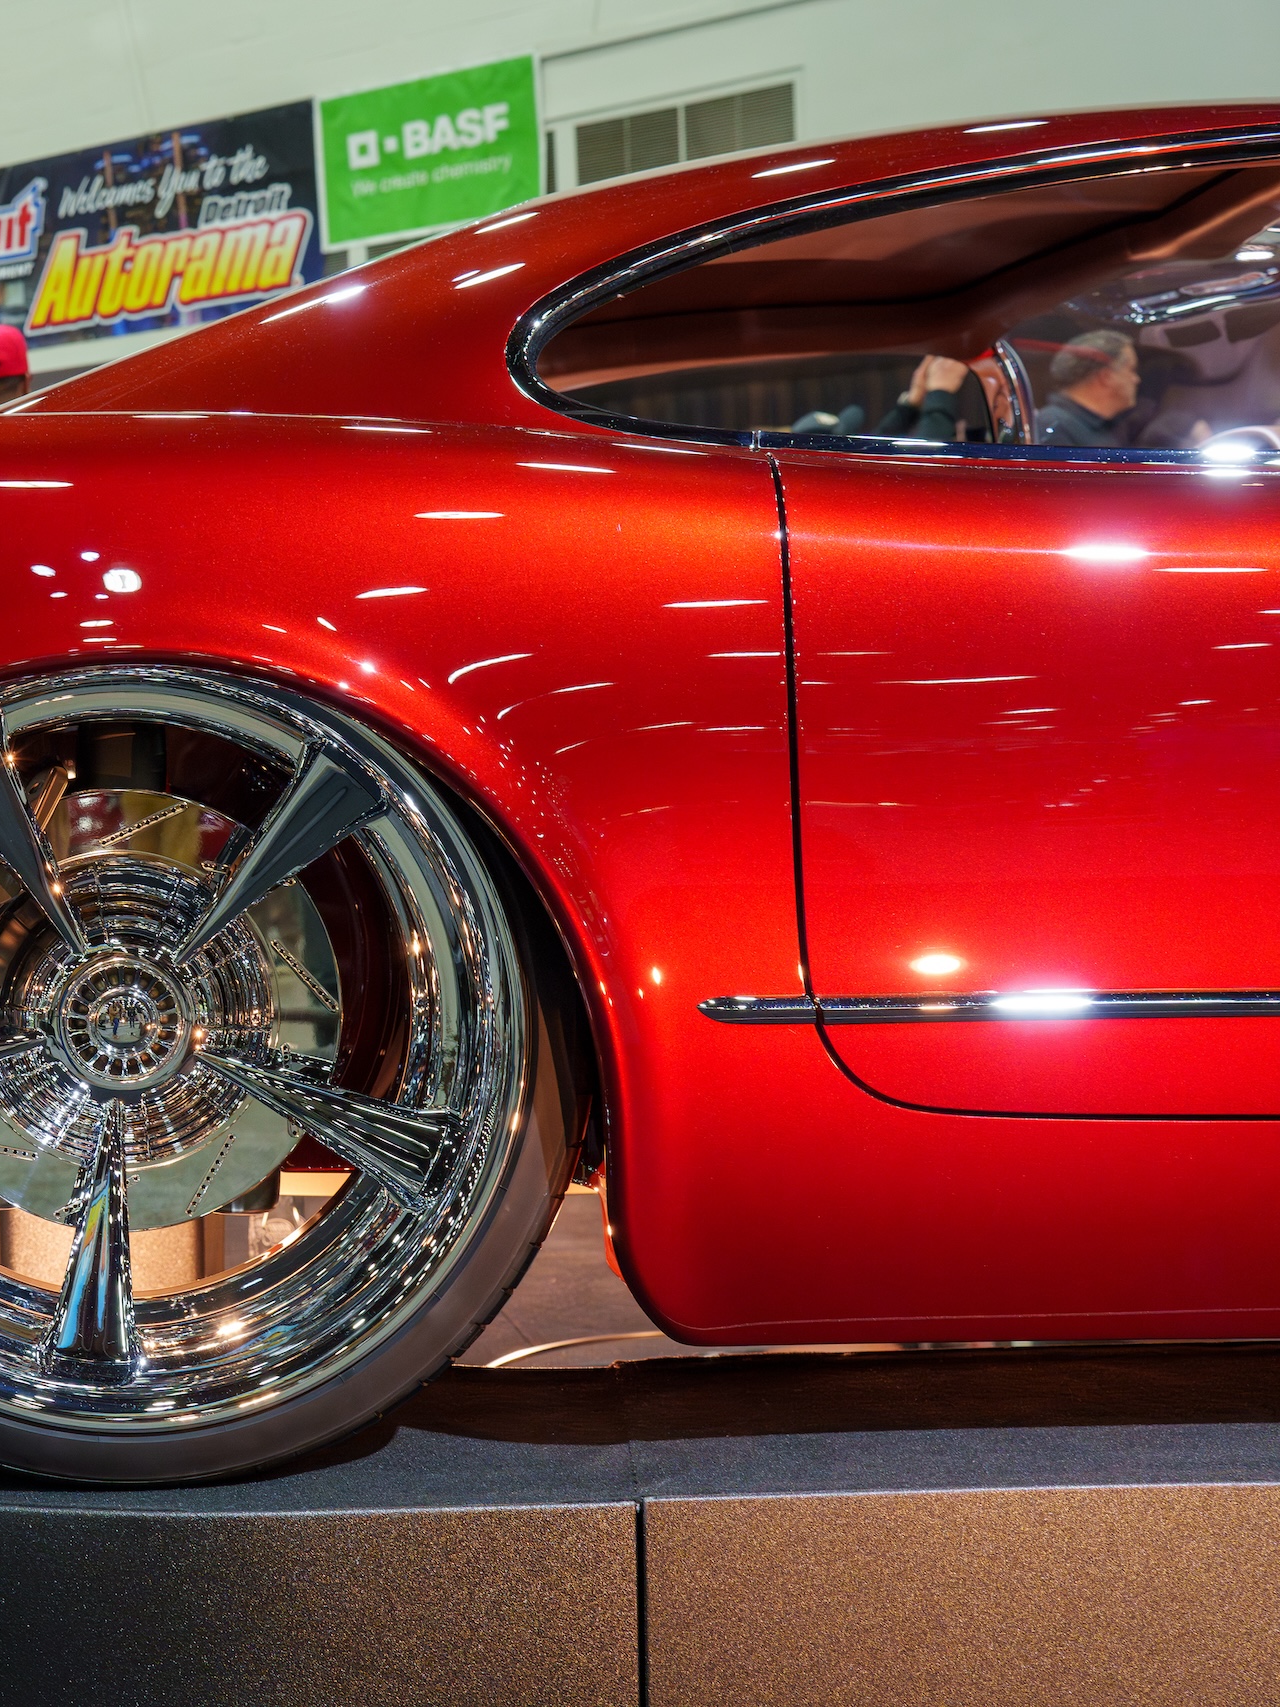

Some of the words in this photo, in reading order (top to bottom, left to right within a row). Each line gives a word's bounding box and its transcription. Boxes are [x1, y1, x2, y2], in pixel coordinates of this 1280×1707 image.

[402, 102, 509, 159] BASF
[58, 174, 156, 219] Welcomes
[155, 164, 200, 219] You
[200, 154, 226, 190] to
[228, 143, 269, 185] the
[27, 210, 309, 332] Autorama
